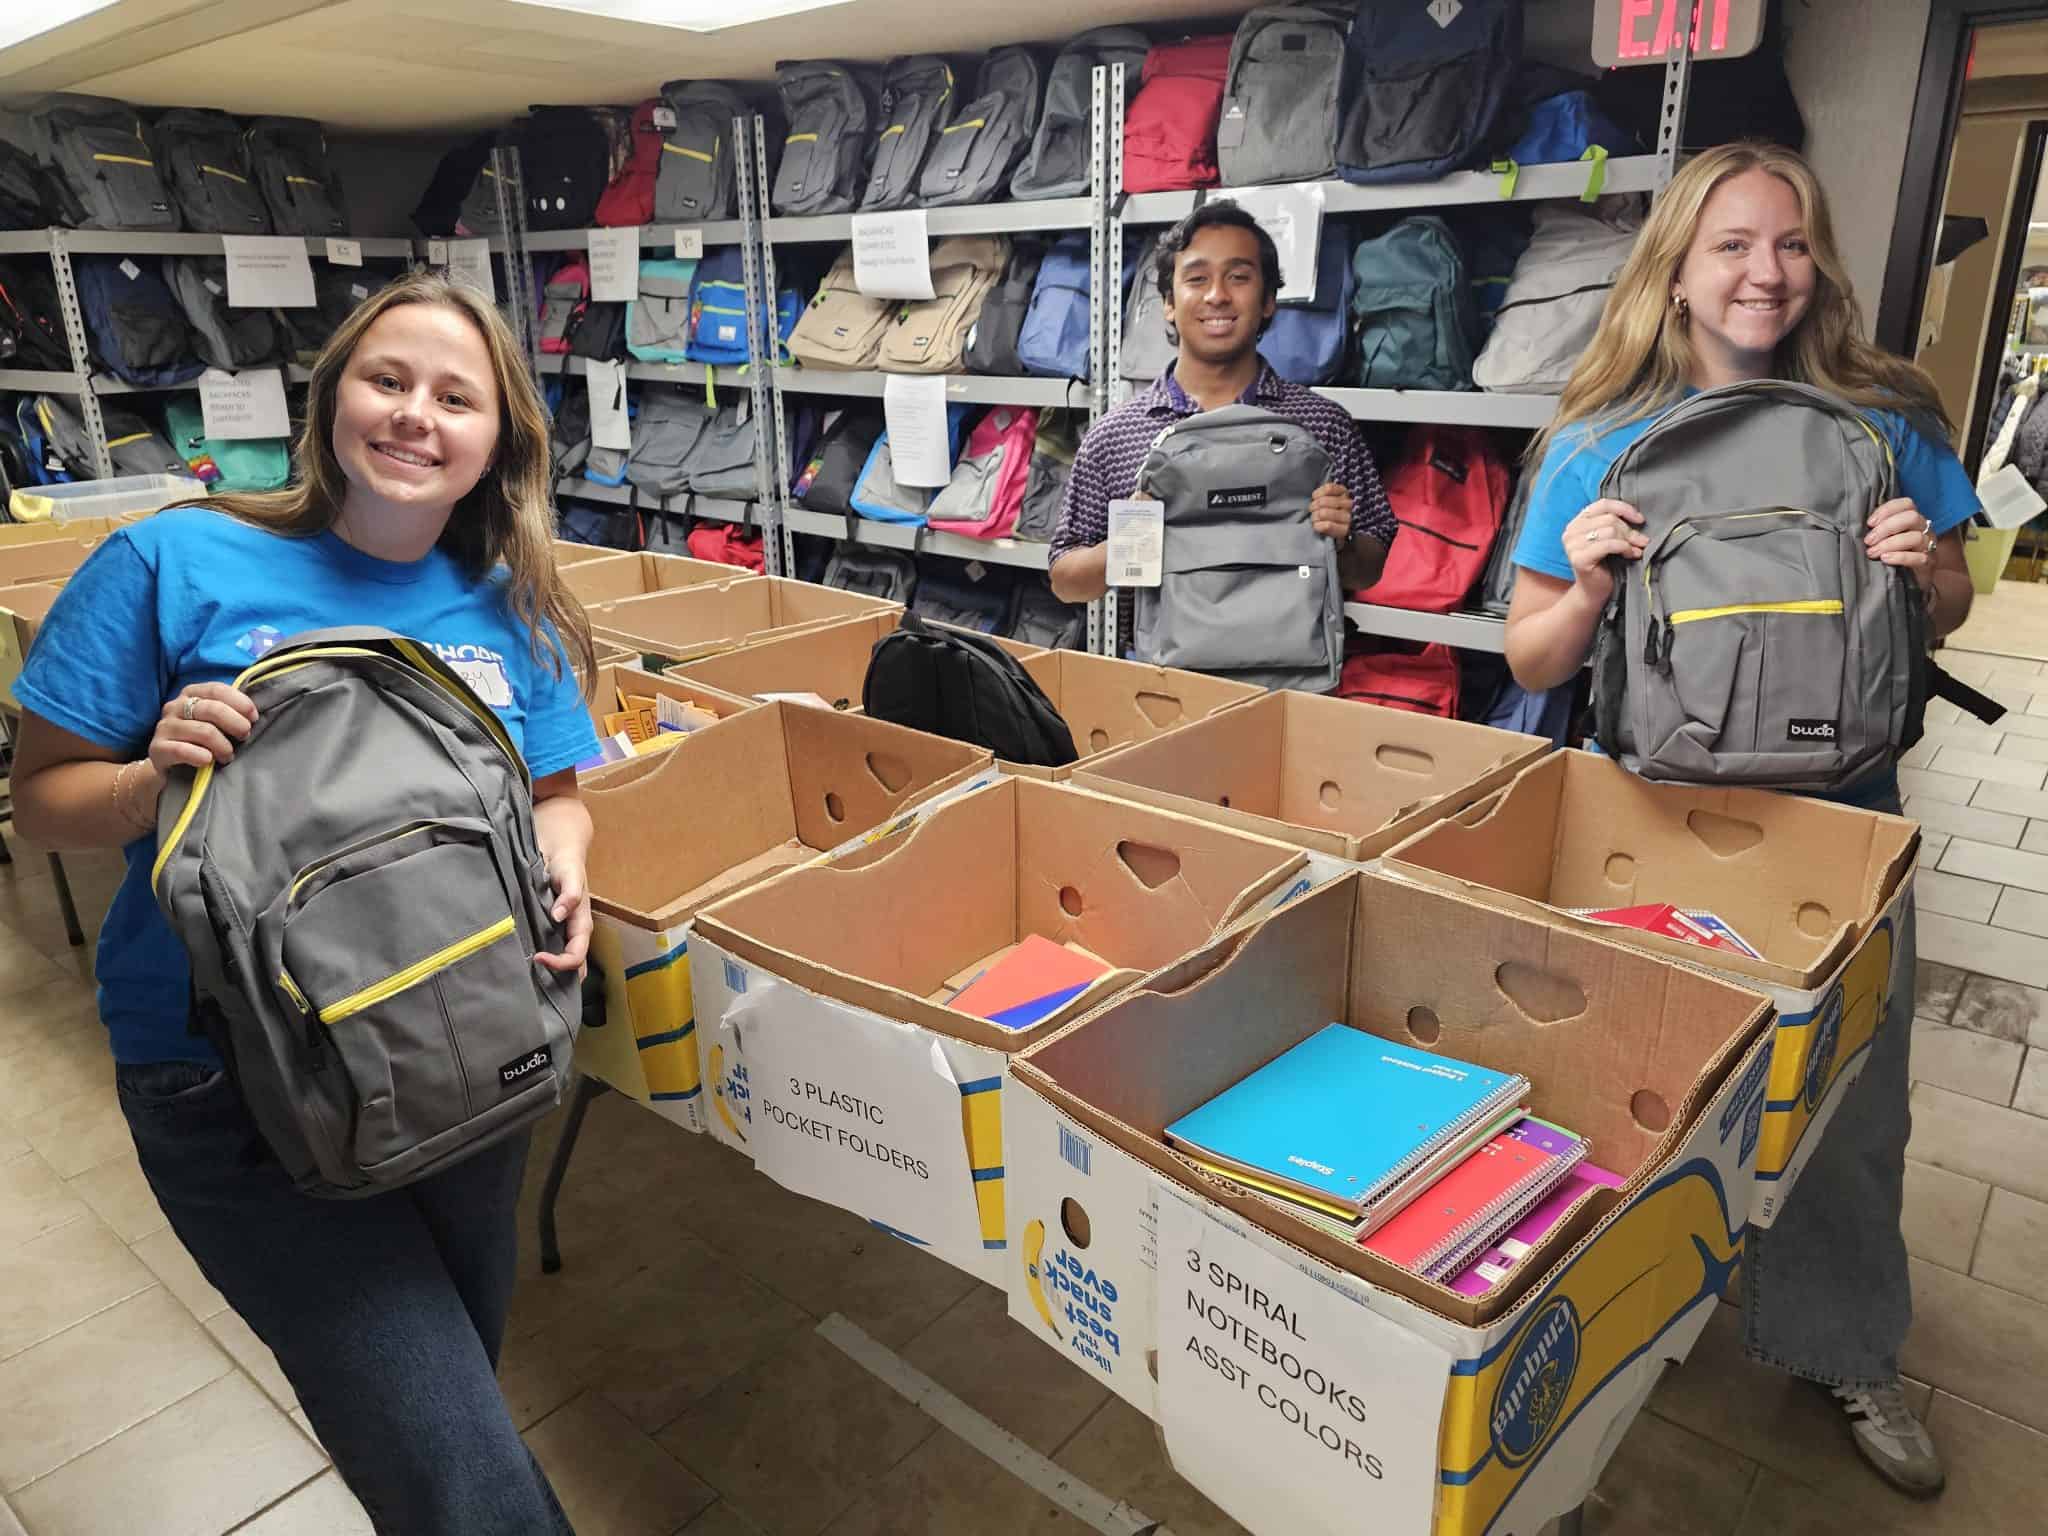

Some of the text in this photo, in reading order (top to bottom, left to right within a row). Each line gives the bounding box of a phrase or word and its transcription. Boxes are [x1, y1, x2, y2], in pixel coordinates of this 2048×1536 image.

[789, 1077, 885, 1125] 3 PLASTIC
[763, 1099, 833, 1143] POCKET
[838, 1128, 929, 1180] FOLDERS
[1044, 1258, 1112, 1322] snack
[1055, 1248, 1119, 1303] ever
[1186, 1248, 1201, 1273] 3
[1208, 1261, 1308, 1342] SPIRAL
[1064, 1300, 1121, 1357] best
[1071, 1335, 1113, 1375] likely
[1186, 1288, 1366, 1423] NOTEBOOKS
[1492, 1300, 1571, 1436] Chiquita
[1185, 1335, 1384, 1480] ASST COLORS
